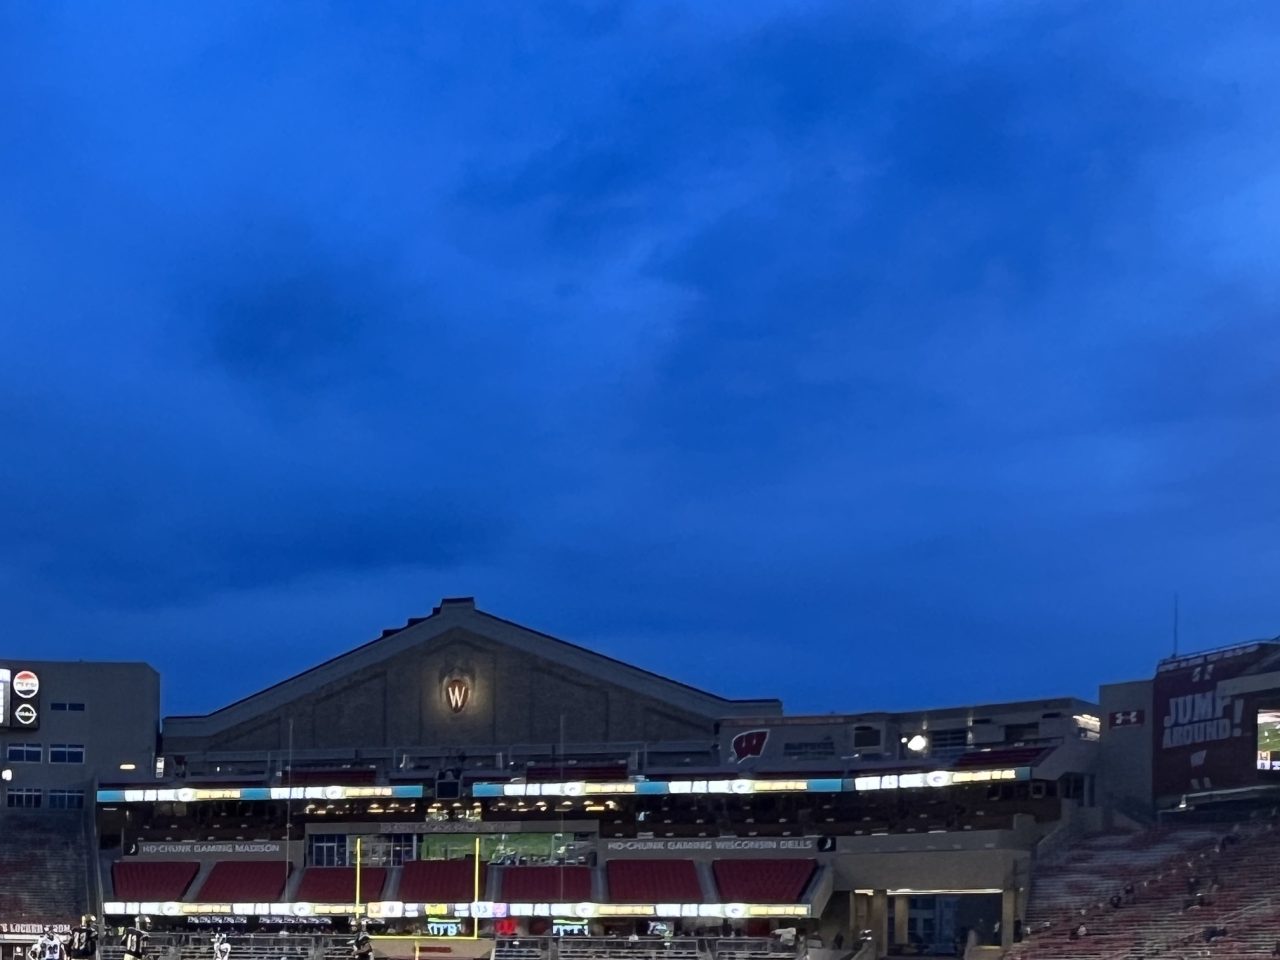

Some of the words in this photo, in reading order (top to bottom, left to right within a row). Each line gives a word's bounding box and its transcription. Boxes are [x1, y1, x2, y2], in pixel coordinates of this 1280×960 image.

[448, 686, 466, 708] W
[234, 844, 280, 852] MADISON
[667, 840, 713, 849] GAMING
[715, 840, 777, 849] WISCONSIN
[780, 840, 813, 849] DELLS
